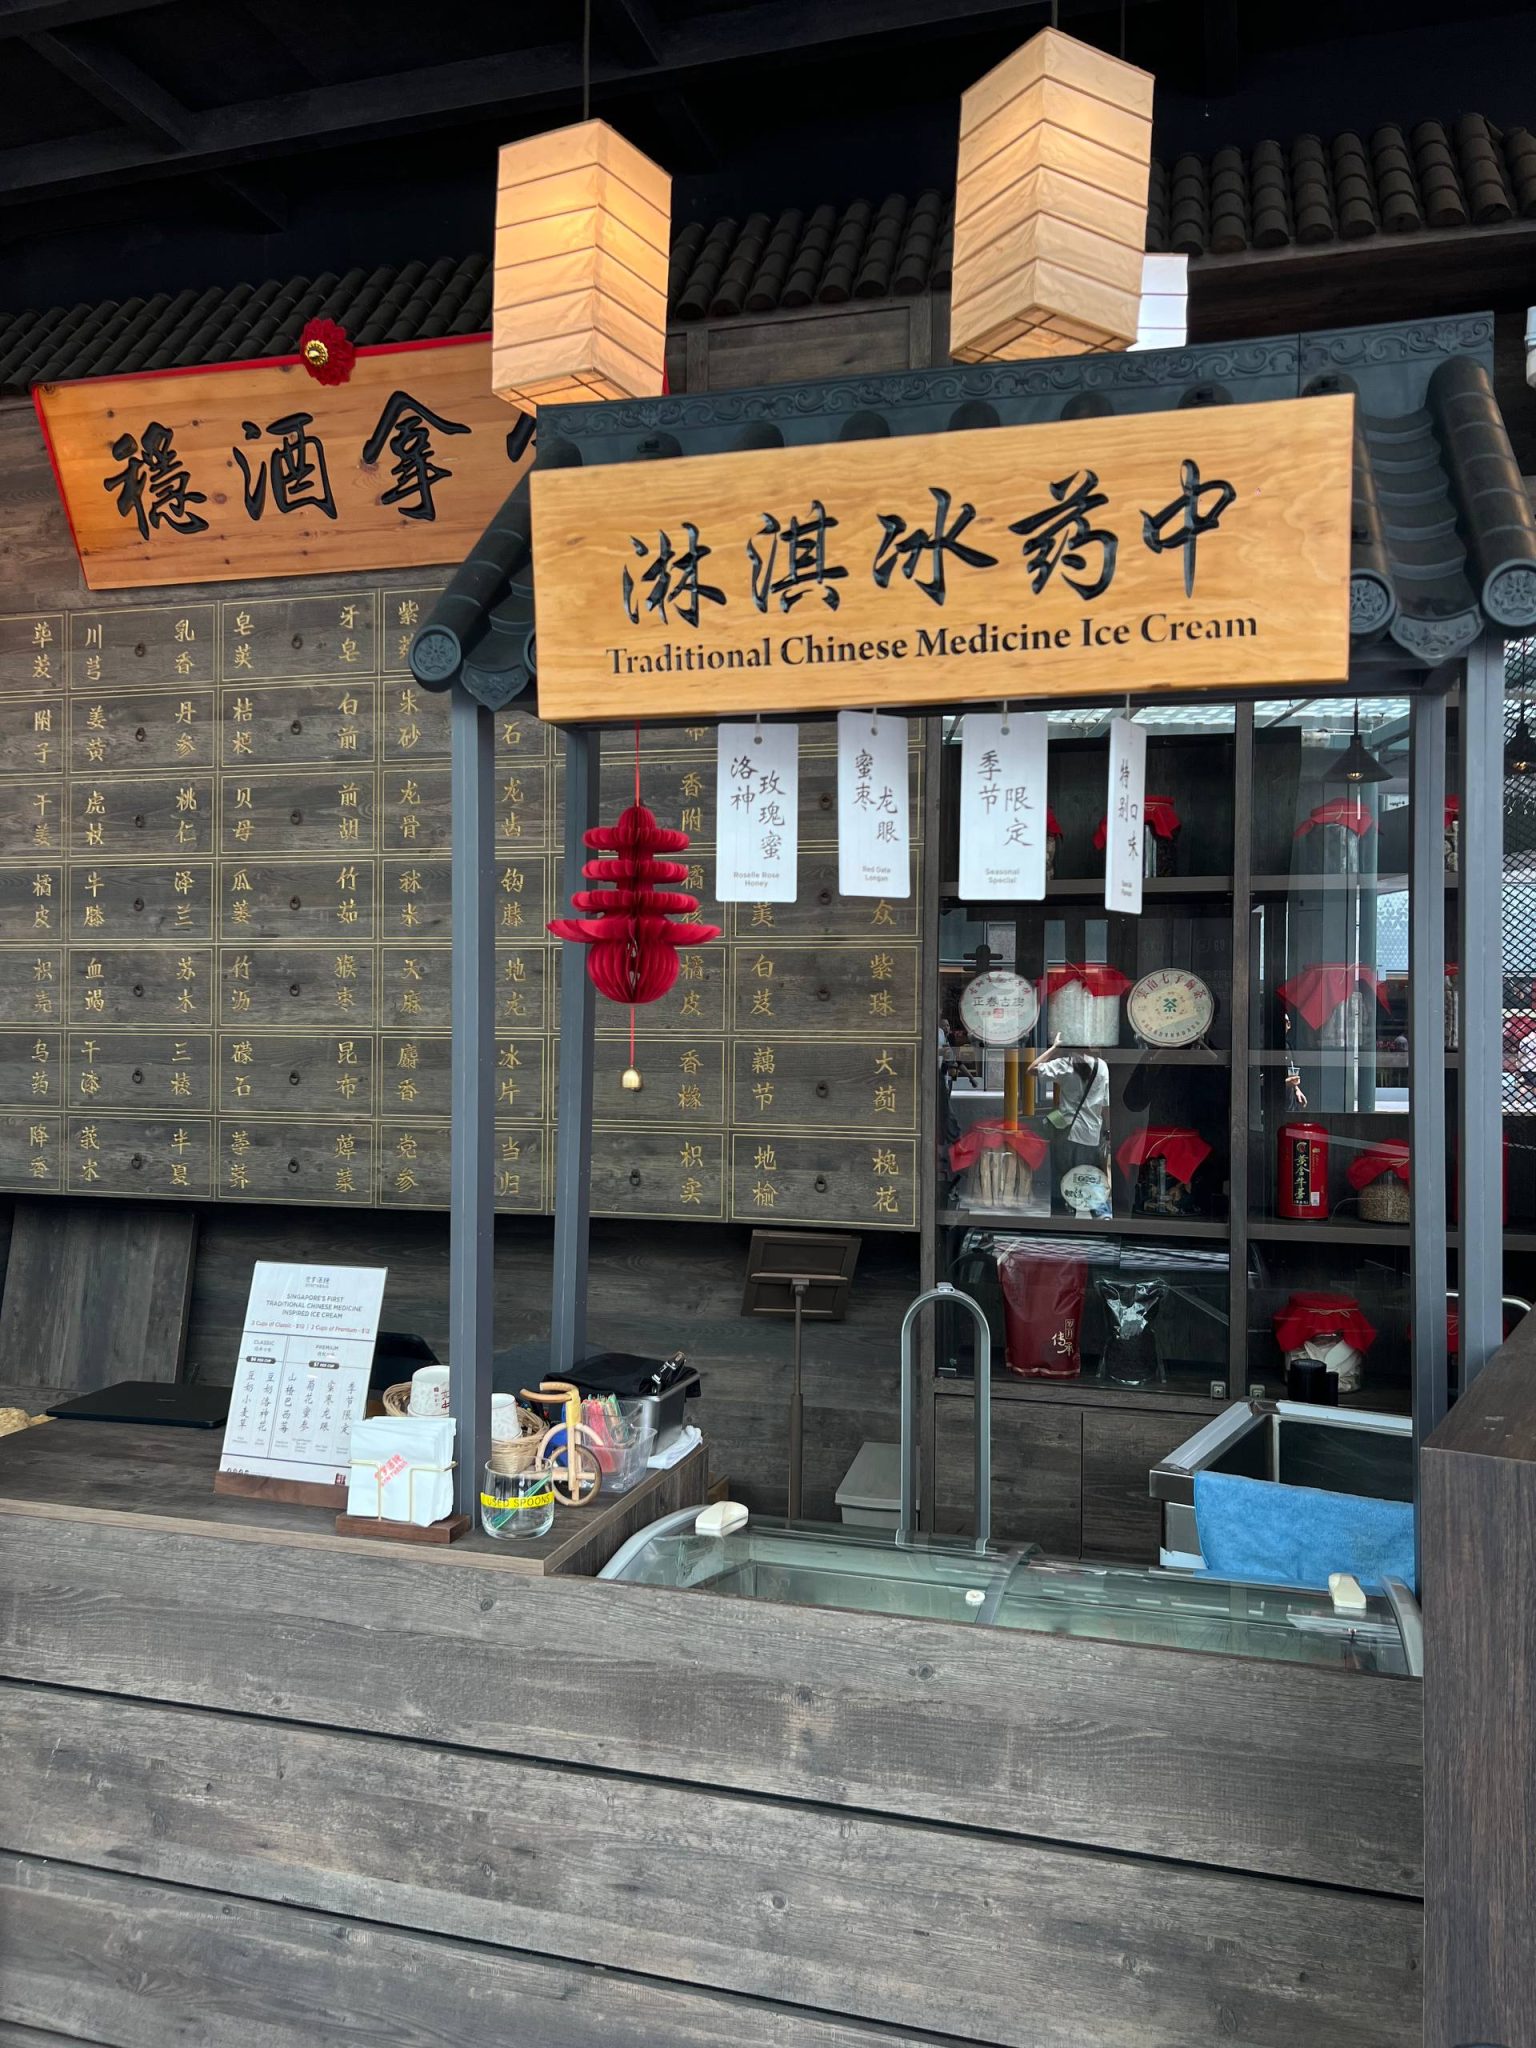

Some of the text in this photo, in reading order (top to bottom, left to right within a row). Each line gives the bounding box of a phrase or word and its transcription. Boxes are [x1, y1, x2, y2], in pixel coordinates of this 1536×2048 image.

[84, 623, 103, 681] 川芎
[174, 618, 196, 675] 乳香
[338, 604, 361, 663] 牙皂
[606, 613, 1257, 674] Traditional Chinese Medicine Ice Cream
[33, 708, 53, 764] 附子
[85, 704, 108, 763] 姜黄
[174, 700, 196, 759] 丹参
[231, 697, 254, 755] 桔梗
[336, 691, 359, 751] 白前
[397, 688, 422, 750] 朱砂
[398, 779, 421, 840] 龙骨
[500, 776, 525, 838] 龙齿
[679, 771, 706, 833] 香附
[730, 755, 759, 815] 洛神
[853, 749, 877, 811] 蜜枣
[977, 750, 1002, 815] 季节
[32, 792, 53, 847] 干姜
[84, 789, 106, 847] 虎杖
[175, 786, 197, 844] 桃仁
[231, 786, 255, 843] 贝母
[337, 781, 361, 841] 前胡
[758, 770, 787, 860] 玫瑰蜜
[876, 786, 900, 843] 龙眼
[1004, 786, 1034, 847] 限定
[32, 873, 53, 929] 橘皮
[83, 871, 106, 929] 牛膝
[173, 870, 195, 927] 泽兰
[335, 866, 359, 924] 竹茹
[745, 880, 768, 888] Honey
[762, 871, 780, 879] Rose
[176, 956, 197, 1014] 苏木
[399, 958, 423, 1014] 天麻
[503, 957, 527, 1018] 地龙
[679, 954, 705, 1017] 橘皮
[868, 952, 897, 1017] 紫珠
[30, 1038, 50, 1095] 乌药
[170, 1041, 193, 1097] 三棱
[335, 1041, 358, 1100] 昆布
[497, 1043, 523, 1106] 冰片
[751, 1046, 777, 1112] 藕节
[28, 1124, 50, 1179] 降香
[169, 1127, 192, 1186] 半夏
[395, 1131, 420, 1193] 党参
[498, 1135, 522, 1198] 当归
[679, 1141, 705, 1205] 枳实
[752, 1144, 780, 1209] 地榆
[871, 1148, 900, 1214] 槐花
[266, 1300, 305, 1308] TRADITIONAL
[282, 1309, 309, 1317] INSPIRED
[287, 1293, 326, 1302] SINGAPORE'S
[487, 1494, 550, 1508] USED SPOONS
